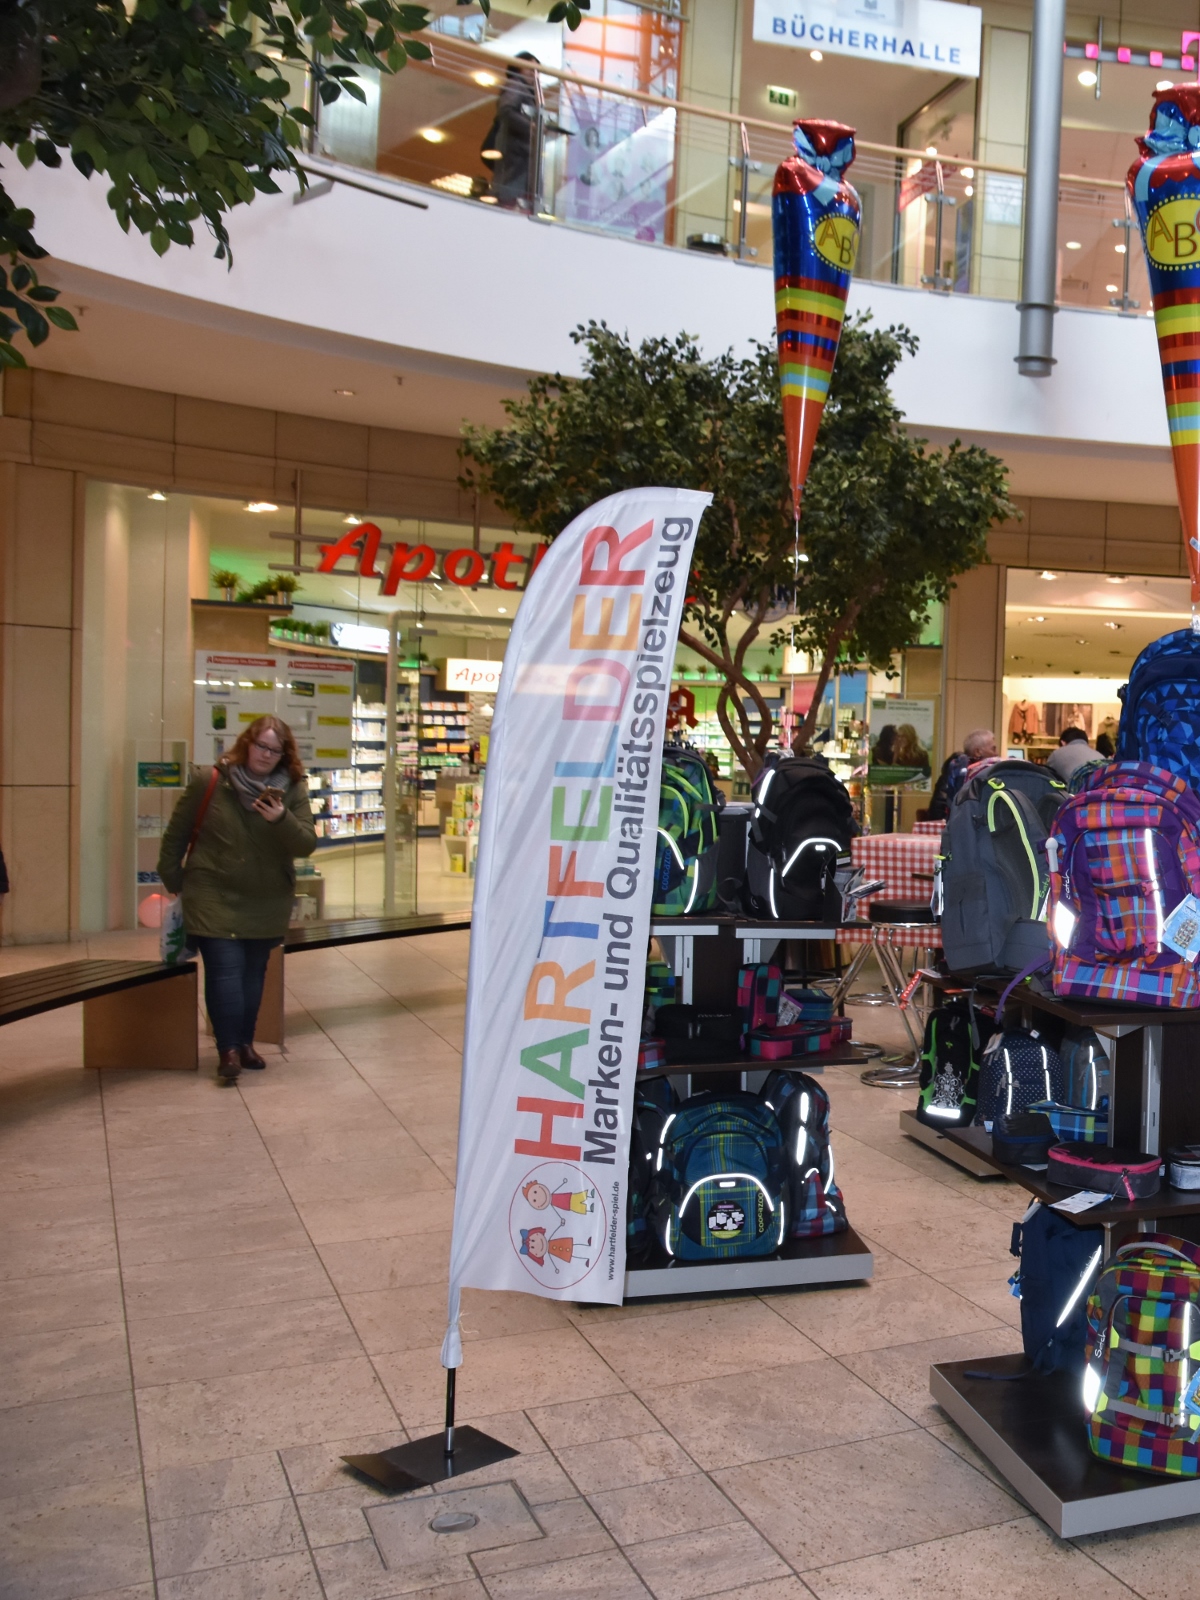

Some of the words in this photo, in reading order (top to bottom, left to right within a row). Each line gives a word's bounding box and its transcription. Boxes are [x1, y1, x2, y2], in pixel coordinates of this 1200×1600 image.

[772, 14, 961, 65] BÜCHERHALLE
[605, 517, 694, 900] Qualitätsspielzeug
[514, 518, 654, 1162] HARTFELDER
[603, 913, 634, 992] und
[583, 1003, 625, 1165] Marken-
[608, 1181, 620, 1281] www.hartfelder-spiel.de
